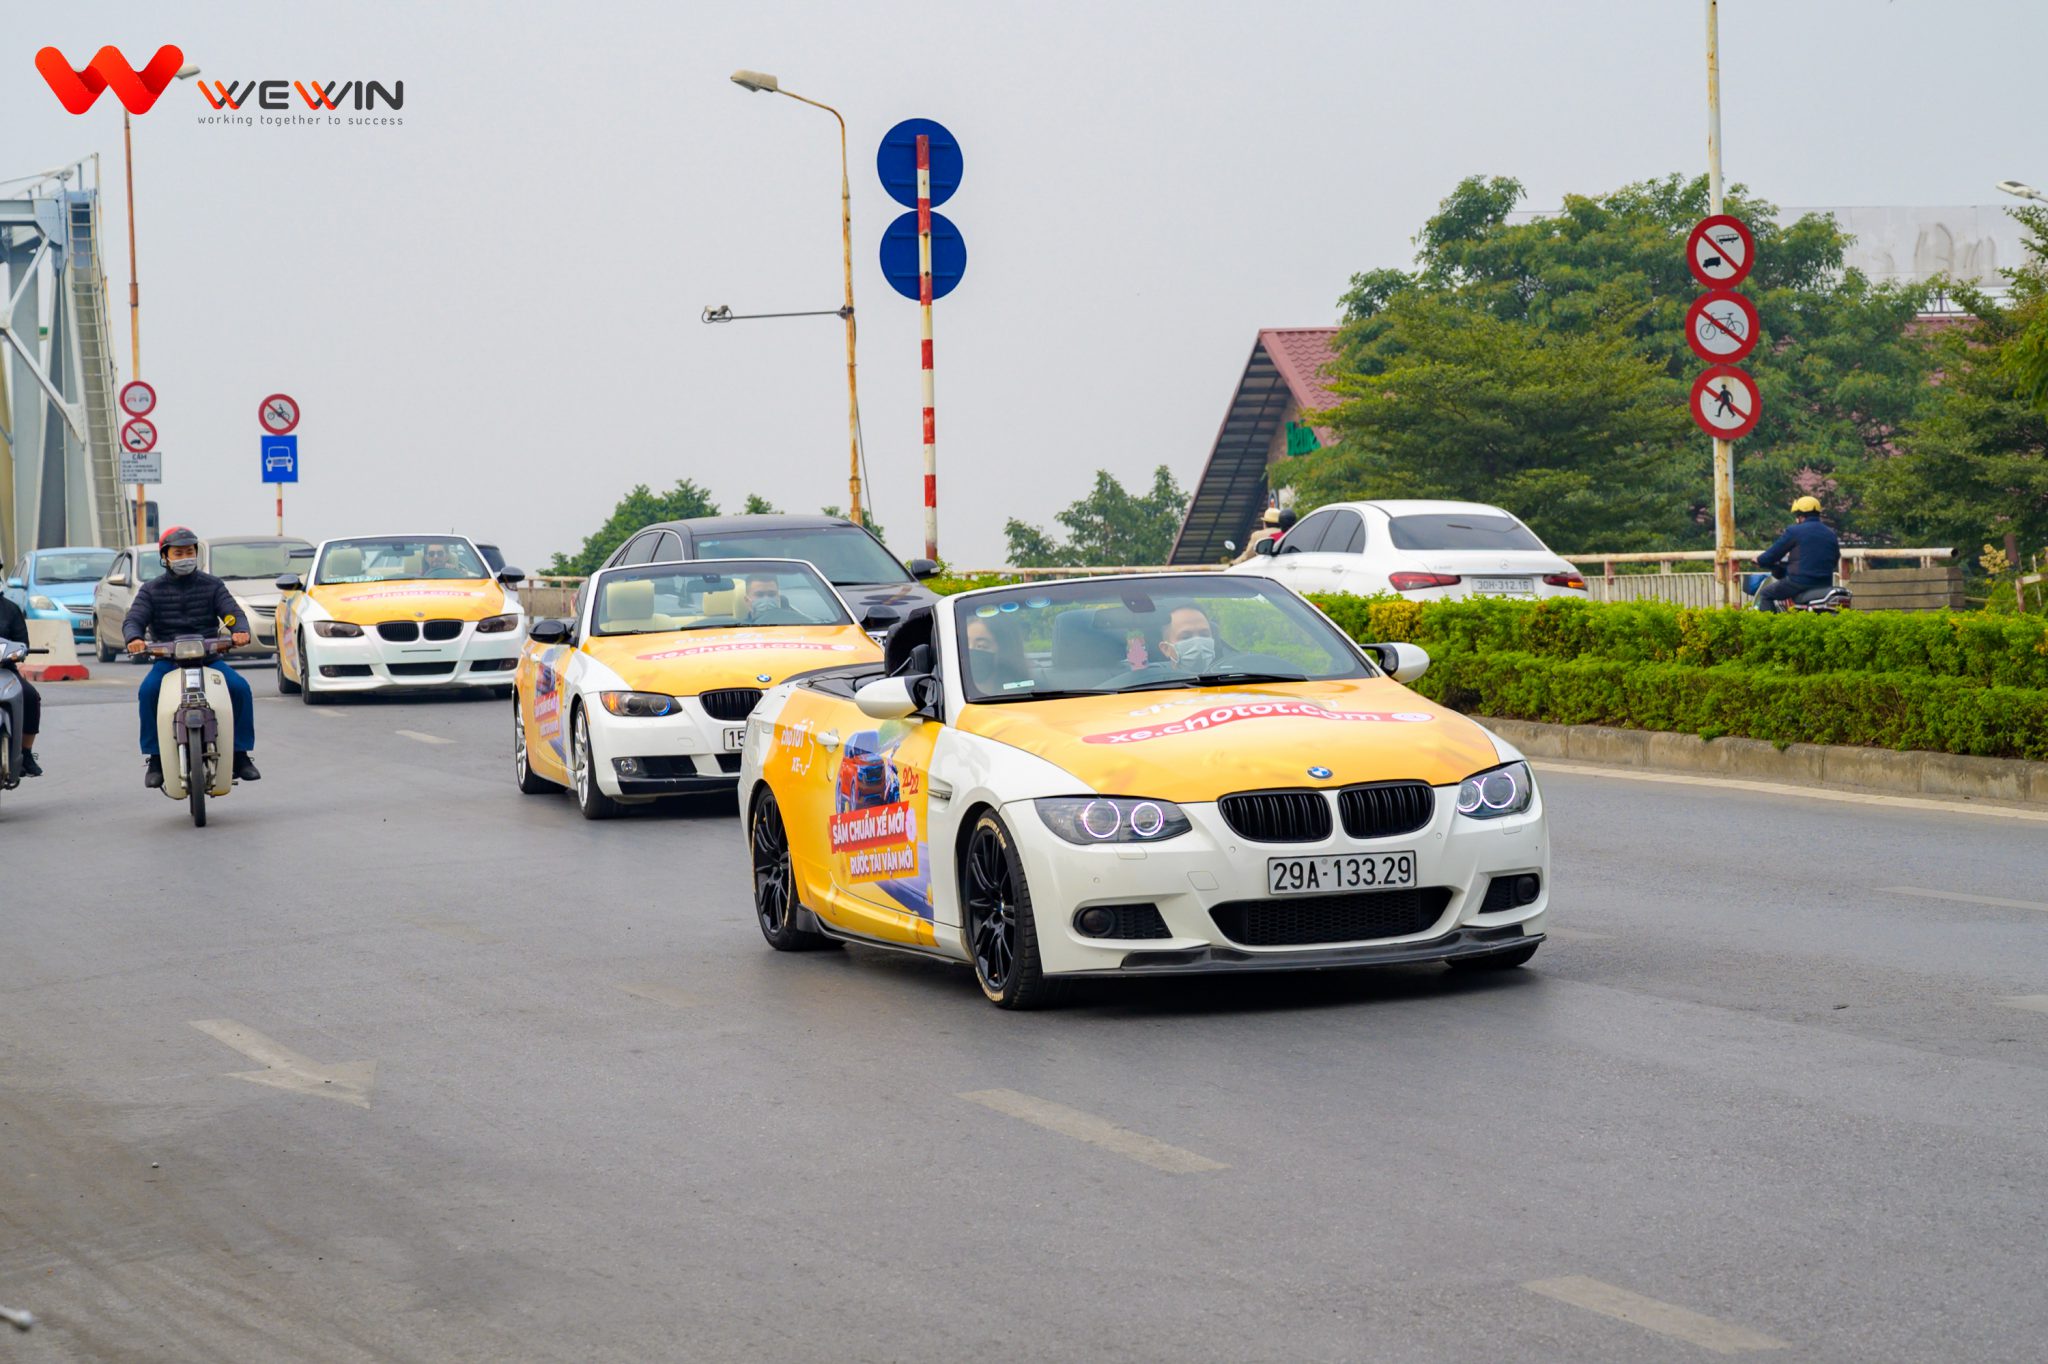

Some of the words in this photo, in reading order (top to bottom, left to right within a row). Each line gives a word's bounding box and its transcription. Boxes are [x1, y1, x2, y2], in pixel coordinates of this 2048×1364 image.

[651, 642, 824, 661] xe.chotot.com
[1108, 702, 1381, 744] xe.chotot.com
[1273, 856, 1412, 891] 29A-133.29
